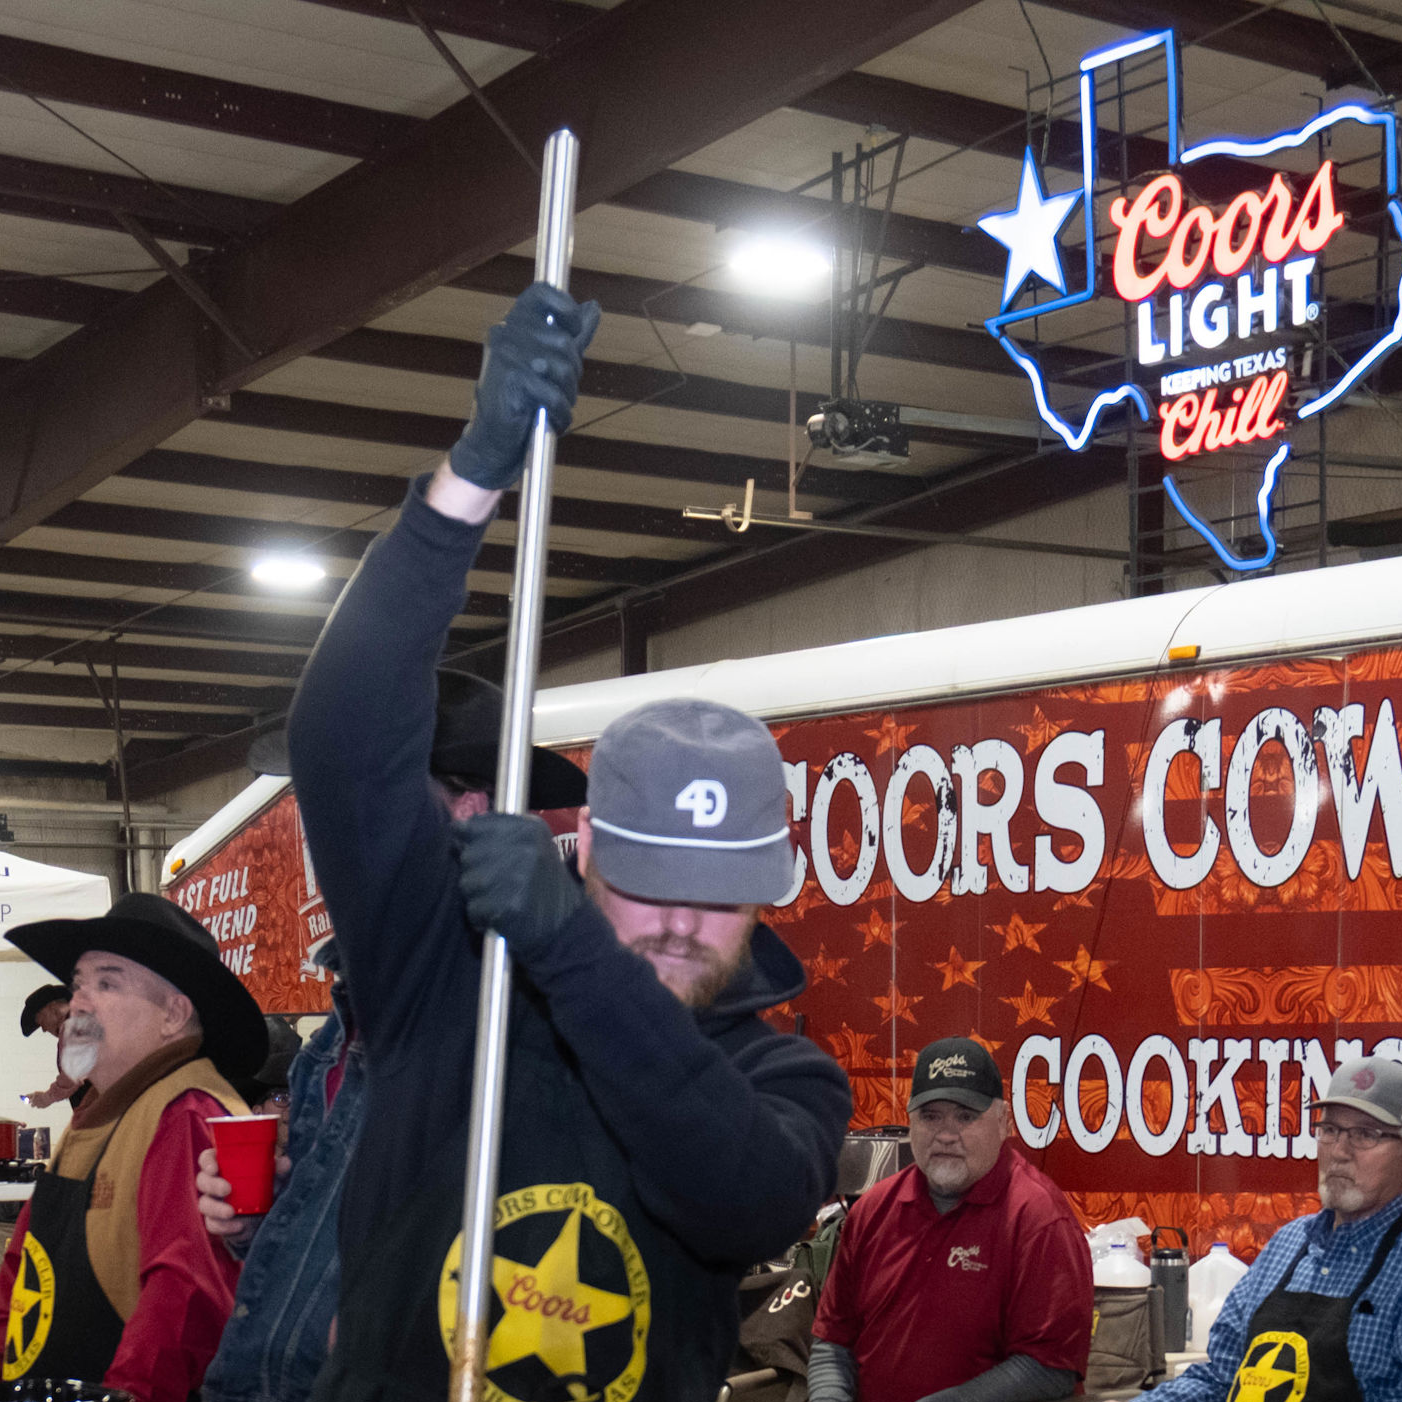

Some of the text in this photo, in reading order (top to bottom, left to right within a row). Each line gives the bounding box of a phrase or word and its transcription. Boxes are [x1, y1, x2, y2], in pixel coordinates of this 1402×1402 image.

[1109, 159, 1345, 301] Coors
[1138, 257, 1316, 365] LIGHT
[1161, 347, 1287, 396] KEEPING TEXAS
[1159, 371, 1289, 461] Chill
[209, 866, 249, 908] FULL
[507, 1272, 591, 1325] Coors
